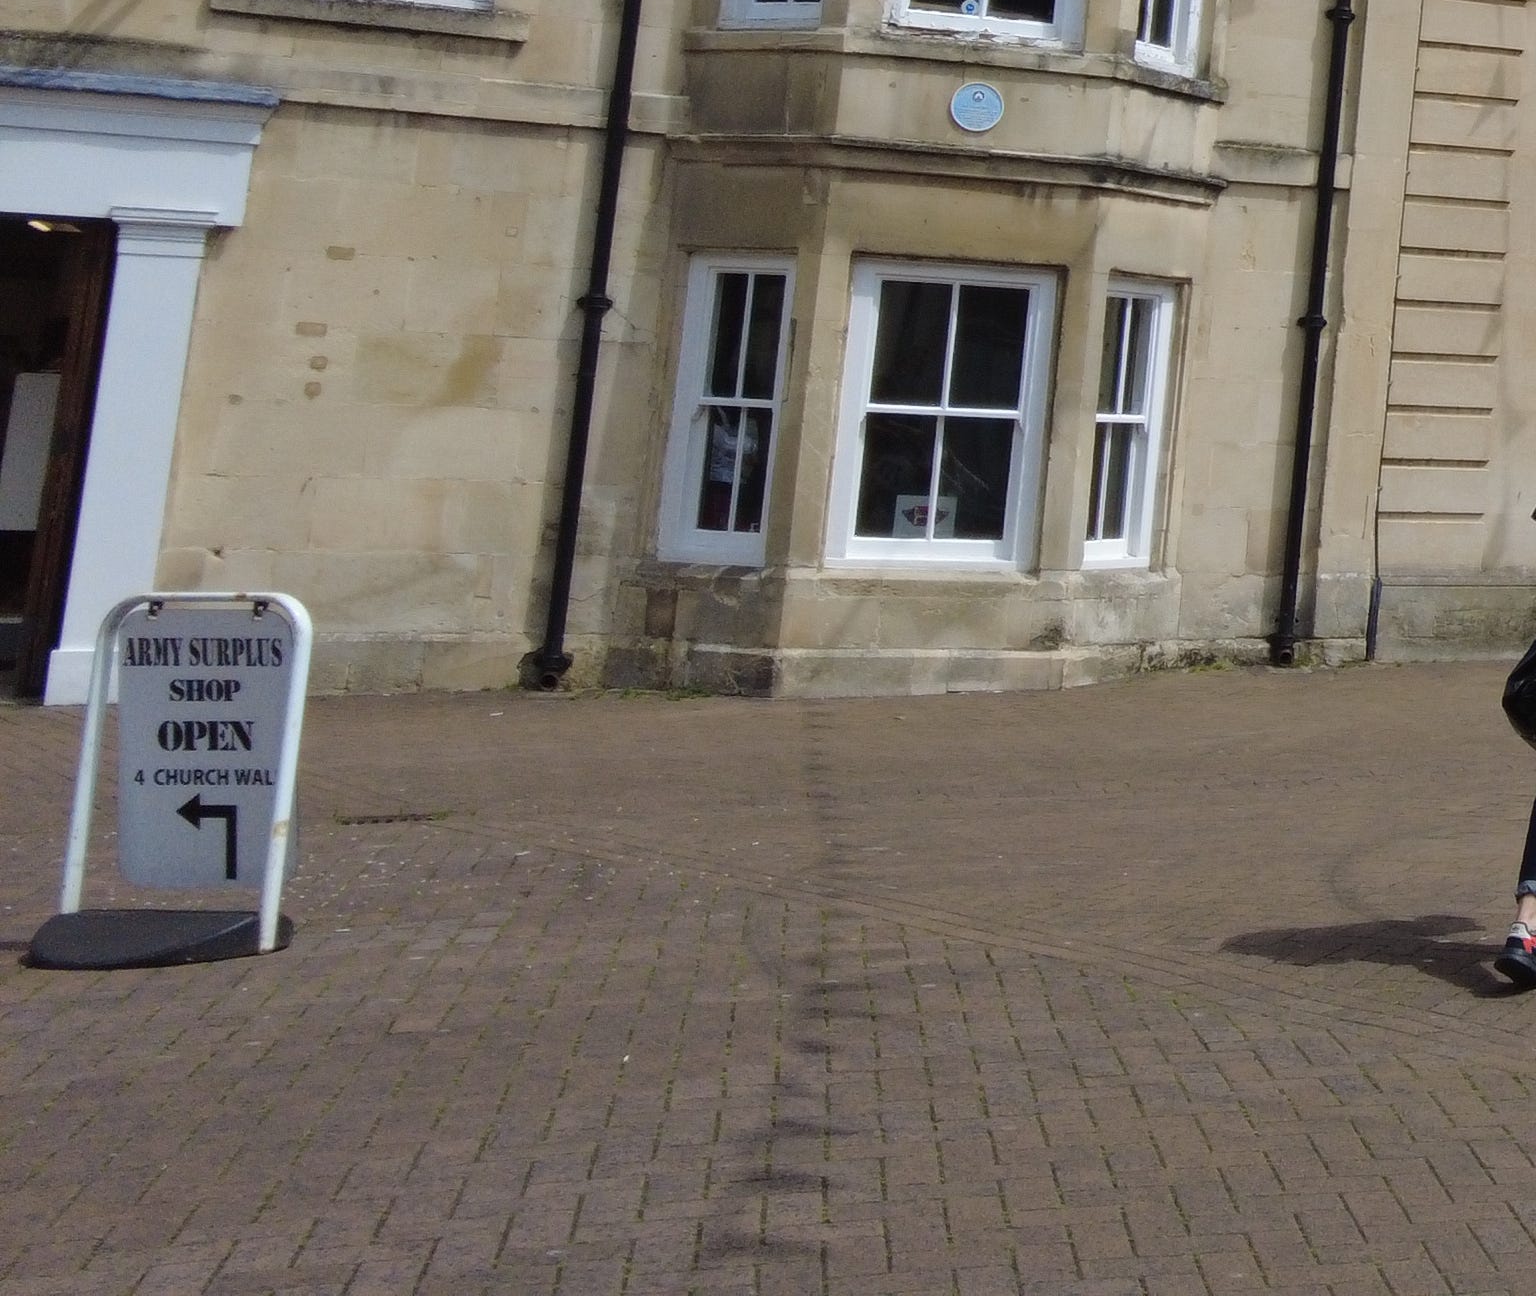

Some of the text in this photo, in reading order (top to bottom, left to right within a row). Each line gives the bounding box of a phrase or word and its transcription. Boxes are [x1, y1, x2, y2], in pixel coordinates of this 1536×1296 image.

[123, 638, 283, 667] ARMY SURPLUS
[169, 679, 241, 701] SHOP
[157, 720, 254, 751] OPEN
[134, 769, 278, 786] 4 CHURCH WAL
